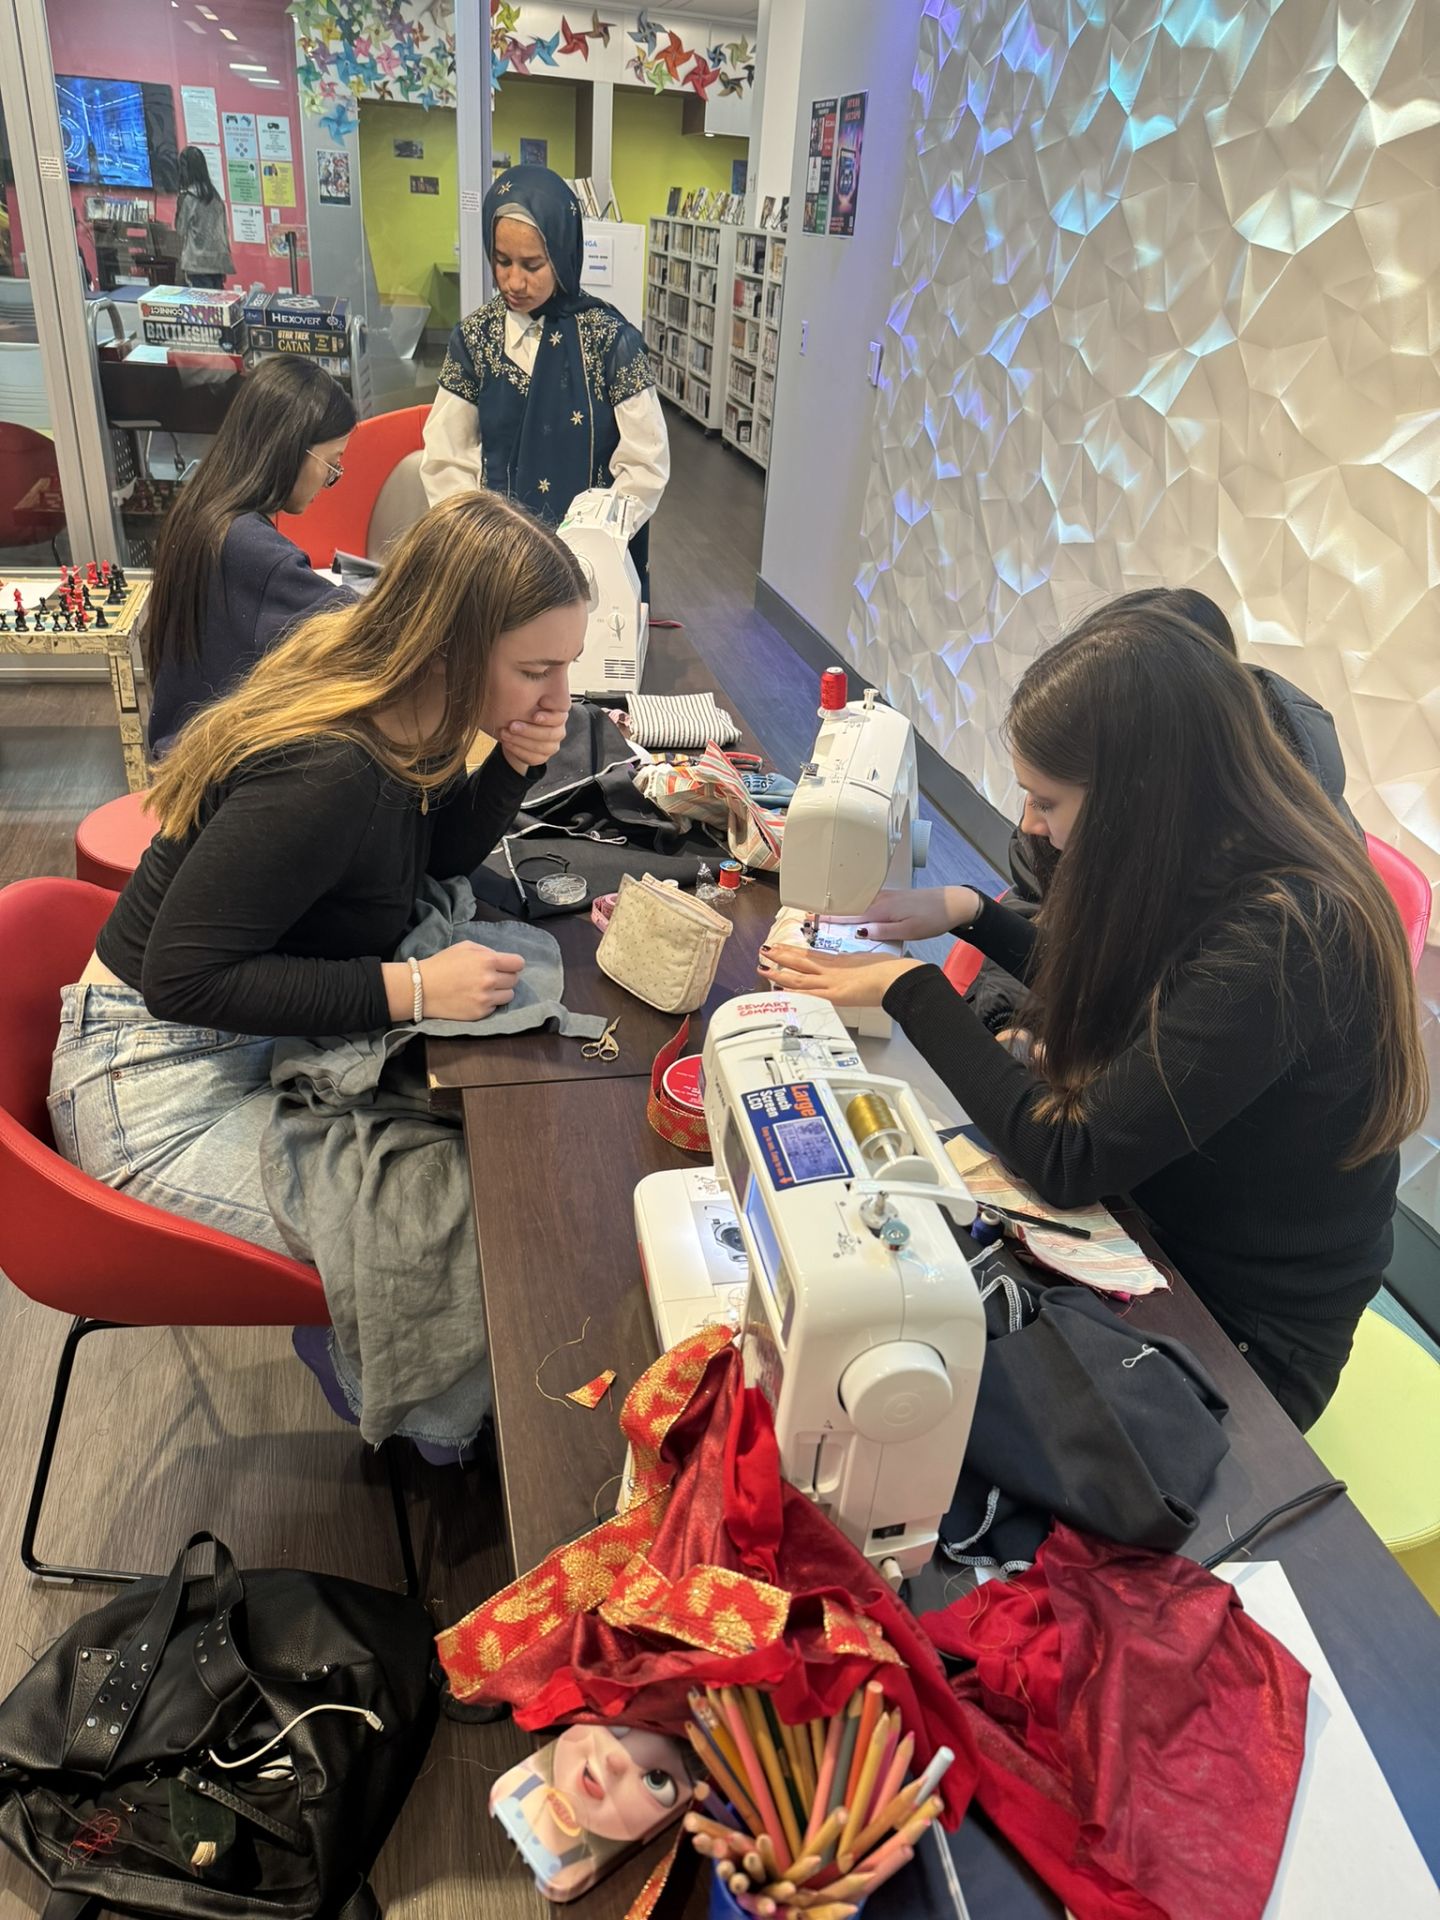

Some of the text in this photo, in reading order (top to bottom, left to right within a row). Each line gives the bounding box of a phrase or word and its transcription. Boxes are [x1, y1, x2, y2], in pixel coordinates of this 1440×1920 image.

[151, 306, 184, 316] CONNECT
[272, 312, 321, 325] HEXOVER
[146, 321, 222, 343] BATTLESHIP
[294, 331, 310, 341] TREK
[278, 339, 311, 353] CATAN
[737, 1001, 790, 1011] SEWART
[746, 1092, 763, 1110] LCD
[760, 1090, 779, 1118] Screen
[773, 1087, 792, 1111] Touch
[790, 1084, 817, 1117] Large
